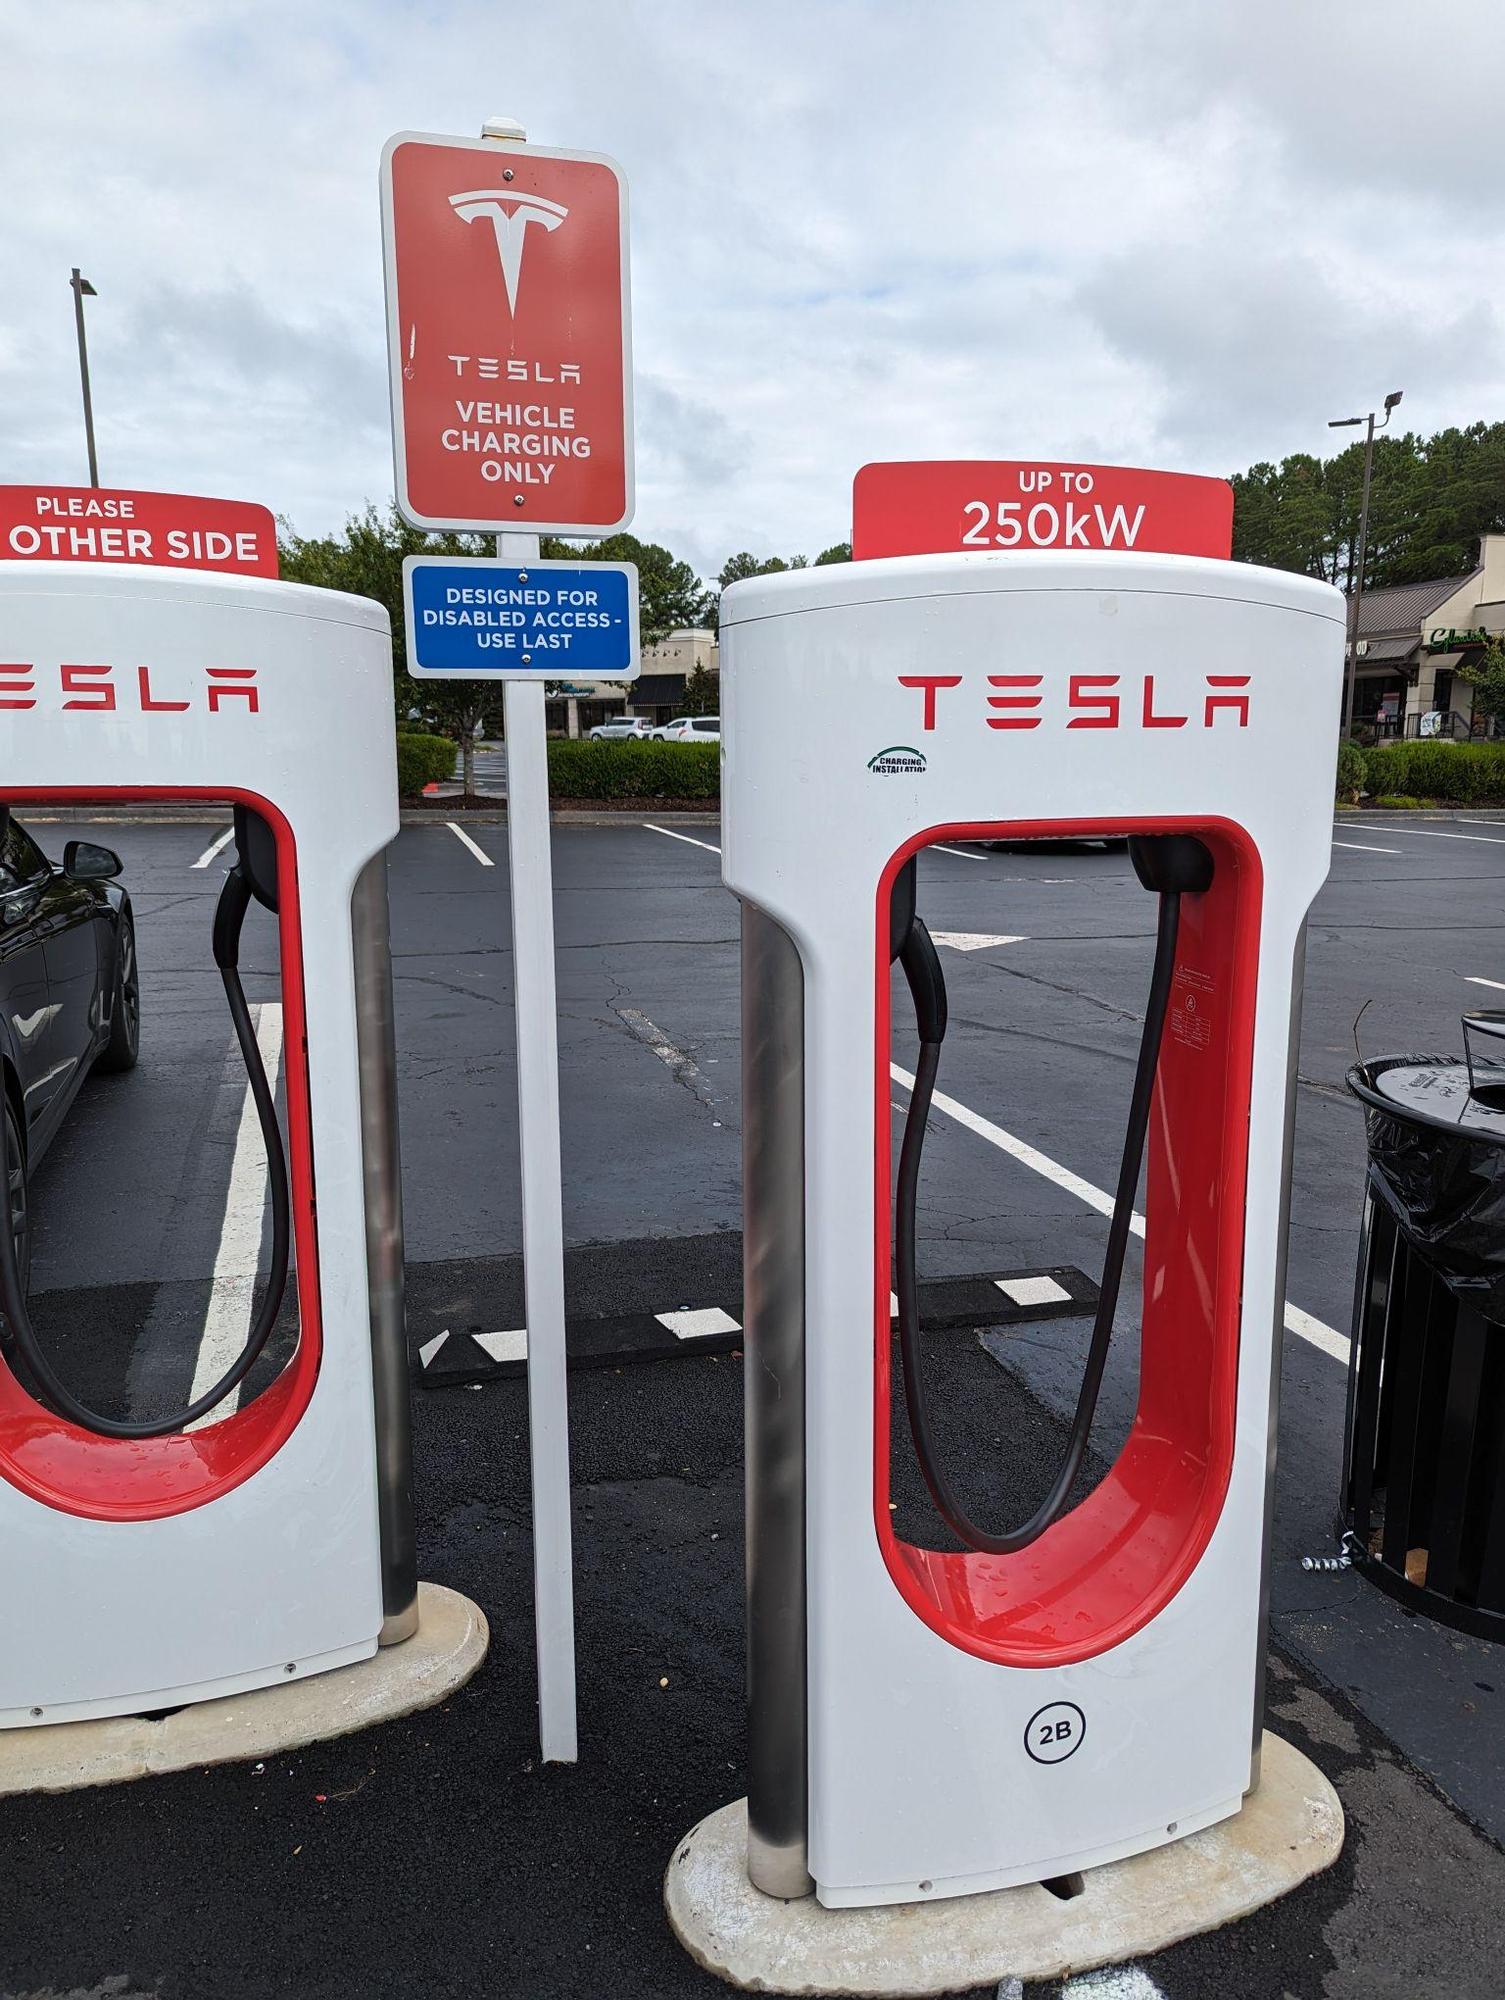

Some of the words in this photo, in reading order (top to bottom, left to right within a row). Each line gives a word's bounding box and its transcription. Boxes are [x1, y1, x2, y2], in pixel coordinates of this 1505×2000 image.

[448, 355, 581, 384] TESLA
[455, 400, 575, 429] VEHICLE
[441, 429, 591, 458] CHARGING
[481, 460, 555, 484] ONLY
[1019, 471, 1052, 492] UP
[1060, 472, 1094, 494] TO
[36, 496, 135, 518] PLEASE
[962, 501, 1146, 547] 250kW
[9, 525, 153, 558] OTHER
[167, 530, 259, 561] SIDE
[446, 588, 550, 606] DESIGNED
[557, 591, 598, 606] FOR
[423, 610, 526, 627] DISABLED
[477, 633, 516, 648] USE
[522, 633, 573, 649] LAST
[897, 674, 1252, 731] TESLA
[879, 757, 922, 766] CHARGING
[1039, 1720, 1072, 1745] 2B
